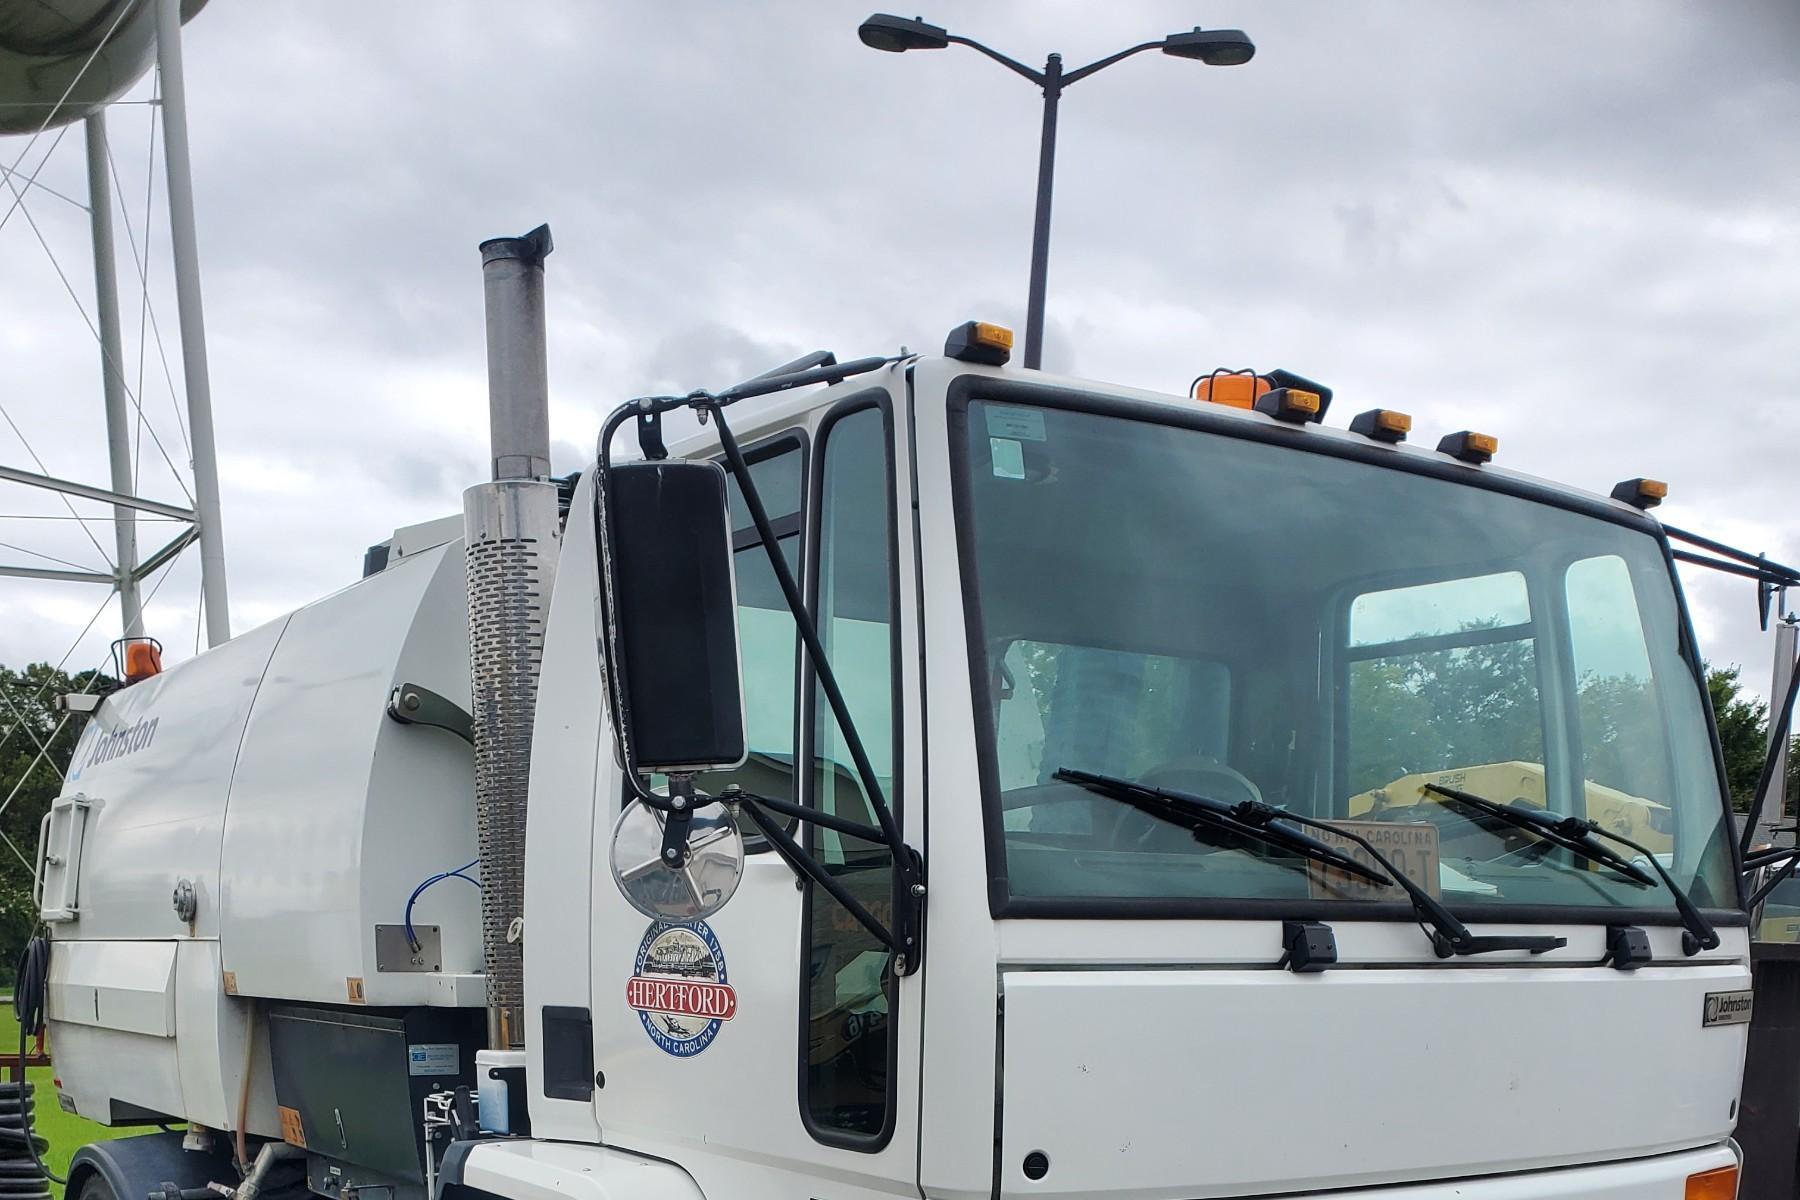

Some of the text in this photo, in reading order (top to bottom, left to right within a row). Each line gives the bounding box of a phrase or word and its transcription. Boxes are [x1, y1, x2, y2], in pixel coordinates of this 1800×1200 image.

[86, 715, 160, 769] Johnston
[1366, 830, 1432, 847] CAROLINA
[632, 980, 729, 1016] HERTFORD
[1718, 995, 1752, 1013] Johnston
[644, 1019, 714, 1054] NORTH CAROLINA
